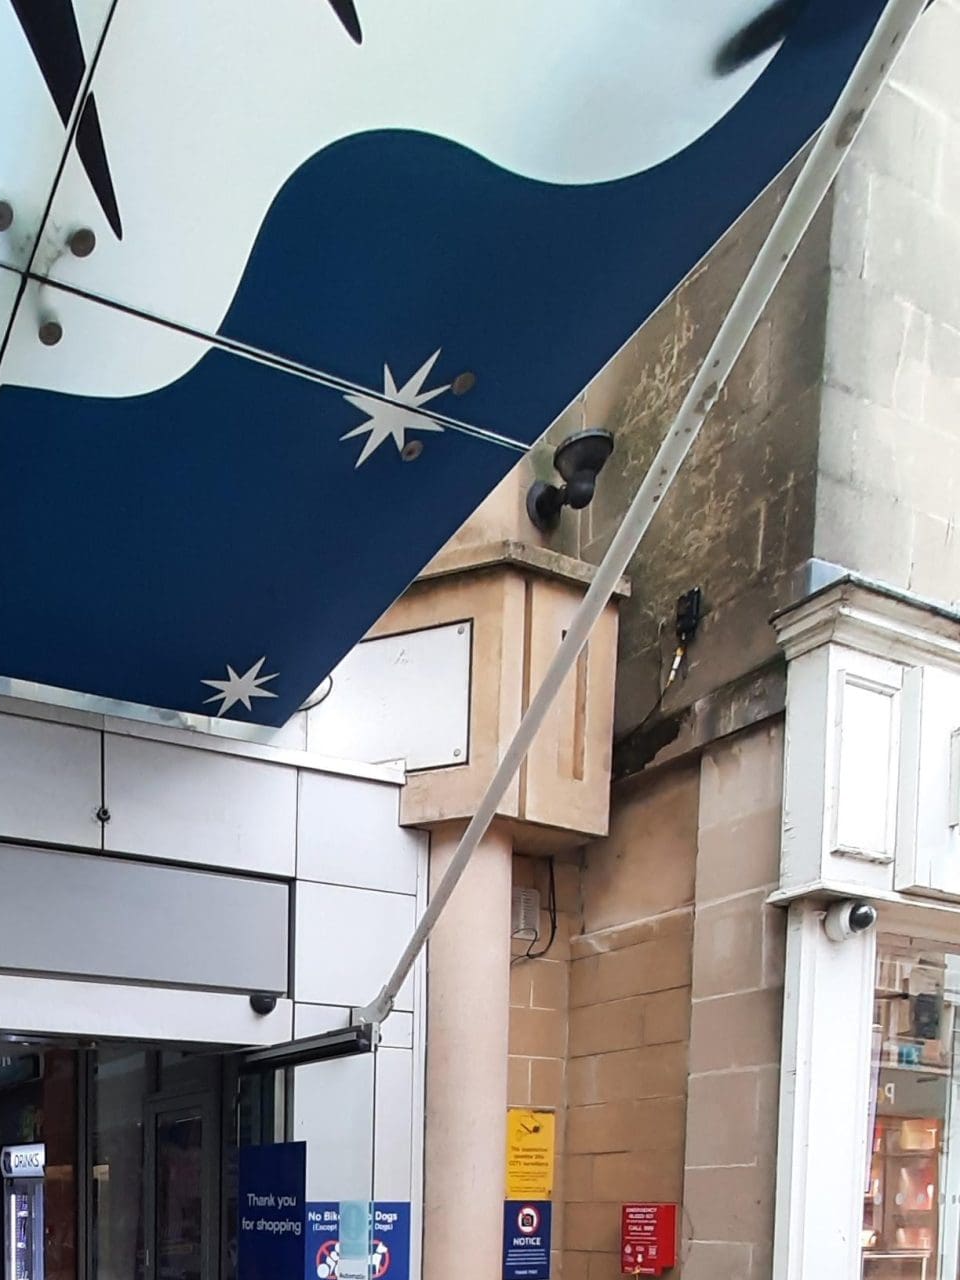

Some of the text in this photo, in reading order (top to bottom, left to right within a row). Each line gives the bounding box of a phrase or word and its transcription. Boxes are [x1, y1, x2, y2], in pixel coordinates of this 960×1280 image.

[14, 1153, 39, 1168] DRINKS
[247, 1193, 296, 1210] Thank you
[308, 1212, 321, 1222] No
[375, 1211, 398, 1224] Dogs
[242, 1218, 302, 1236] for shopping
[374, 1222, 394, 1232] Dogs)
[513, 1237, 541, 1246] NOTICE
